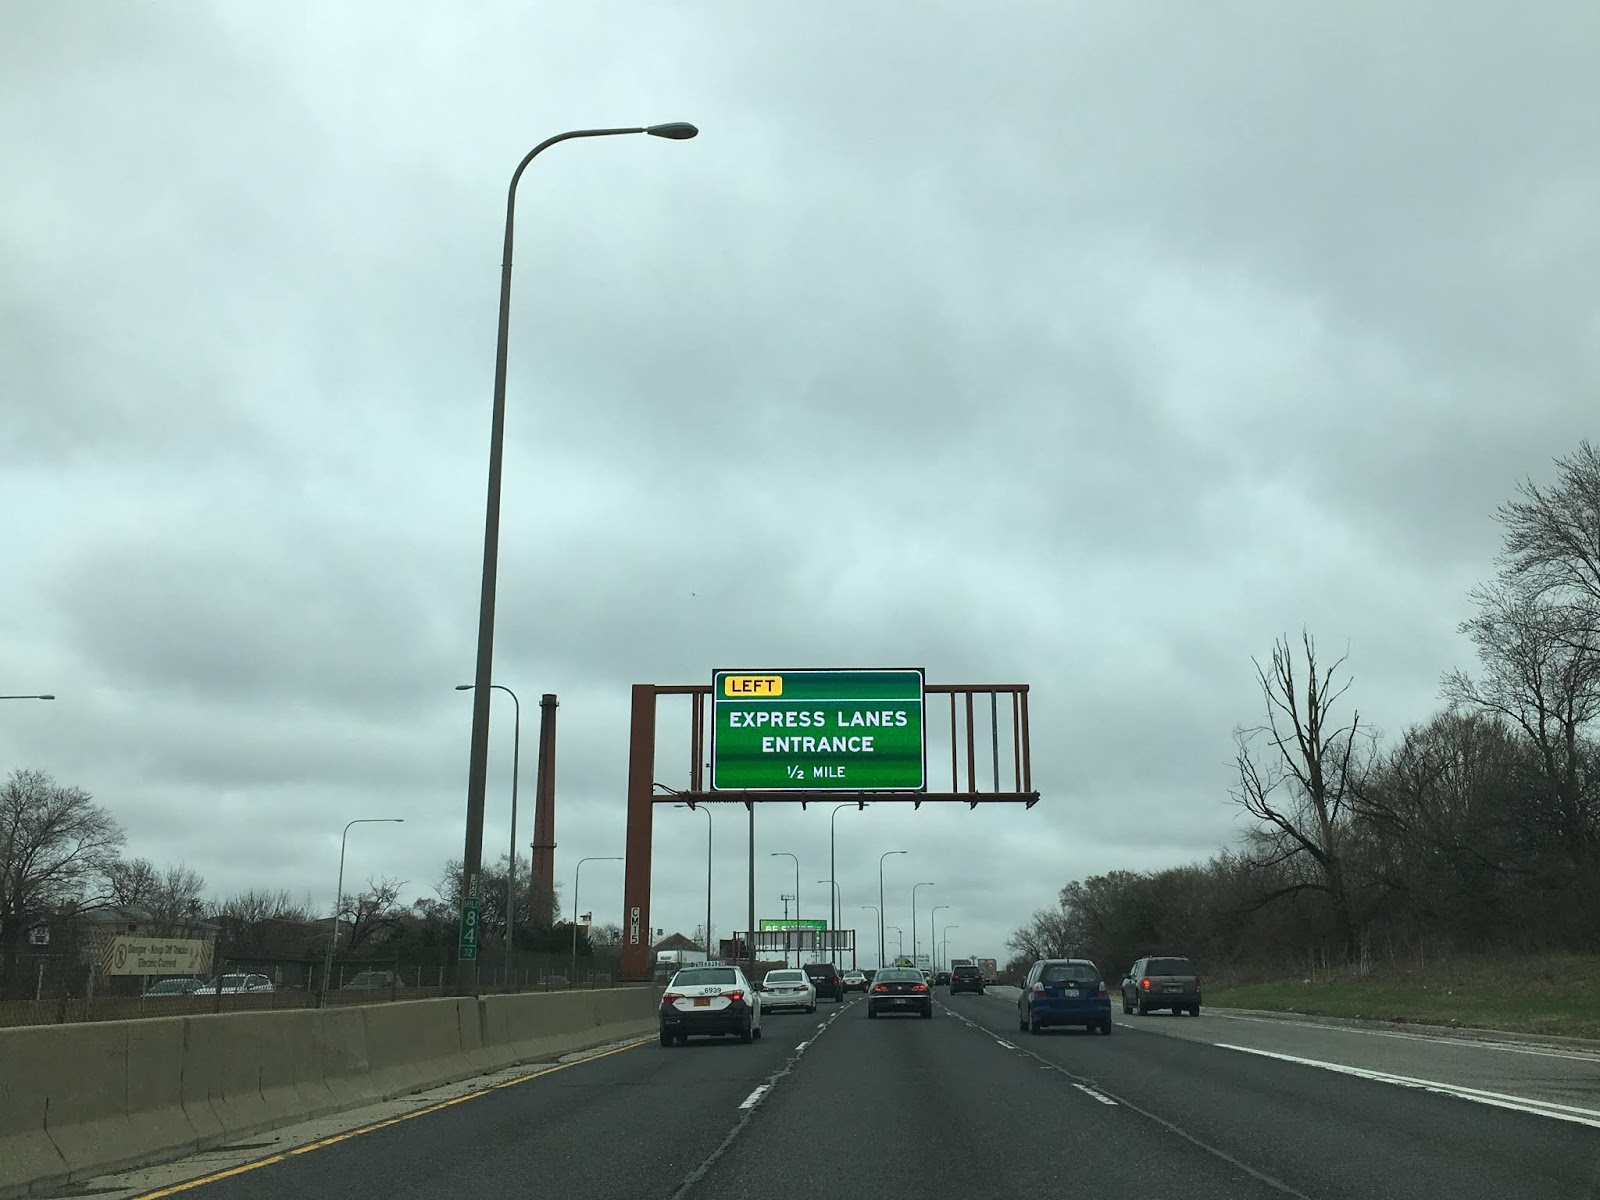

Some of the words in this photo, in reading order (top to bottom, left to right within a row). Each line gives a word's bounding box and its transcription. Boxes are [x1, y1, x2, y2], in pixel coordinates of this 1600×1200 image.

[732, 679, 775, 692] LEFT
[729, 711, 825, 727] EXPRESS
[837, 710, 908, 727] LANES
[762, 736, 874, 753] ENTRANCE
[787, 765, 804, 779] 1/2
[813, 766, 846, 778] MILE
